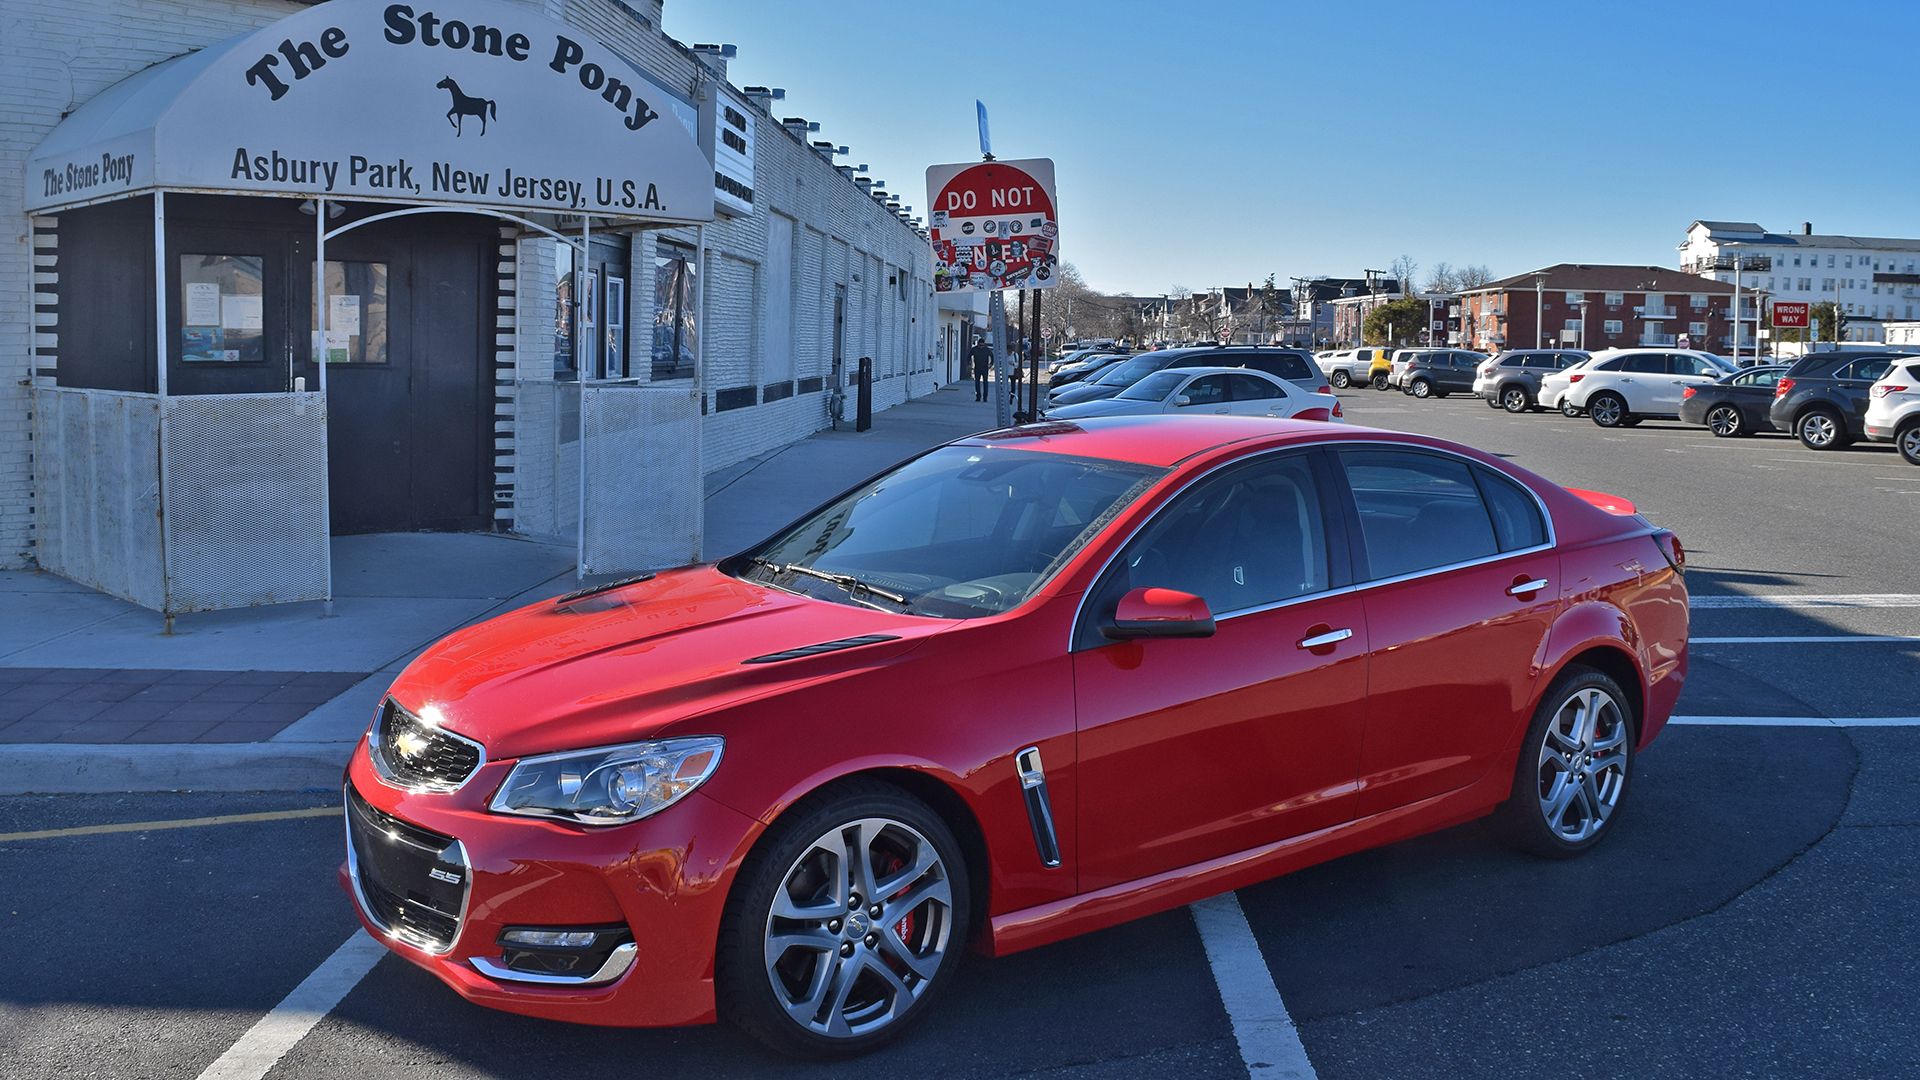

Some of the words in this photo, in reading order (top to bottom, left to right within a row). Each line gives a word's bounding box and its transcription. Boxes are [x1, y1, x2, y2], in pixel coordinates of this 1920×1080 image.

[246, 28, 350, 102] The
[383, 4, 531, 62] Stone
[548, 34, 659, 131] Pony
[44, 168, 64, 198] The
[66, 163, 99, 193] Stone
[102, 152, 135, 187] Pony
[231, 148, 339, 192] Asbury
[350, 156, 421, 195] Park,
[432, 162, 490, 195] New
[498, 169, 586, 209] Jersey,
[596, 178, 667, 212] U.S.A.
[947, 191, 976, 210] DO
[991, 187, 1035, 208] NOT
[1777, 306, 1805, 314] WRONG
[429, 868, 462, 885] SS
